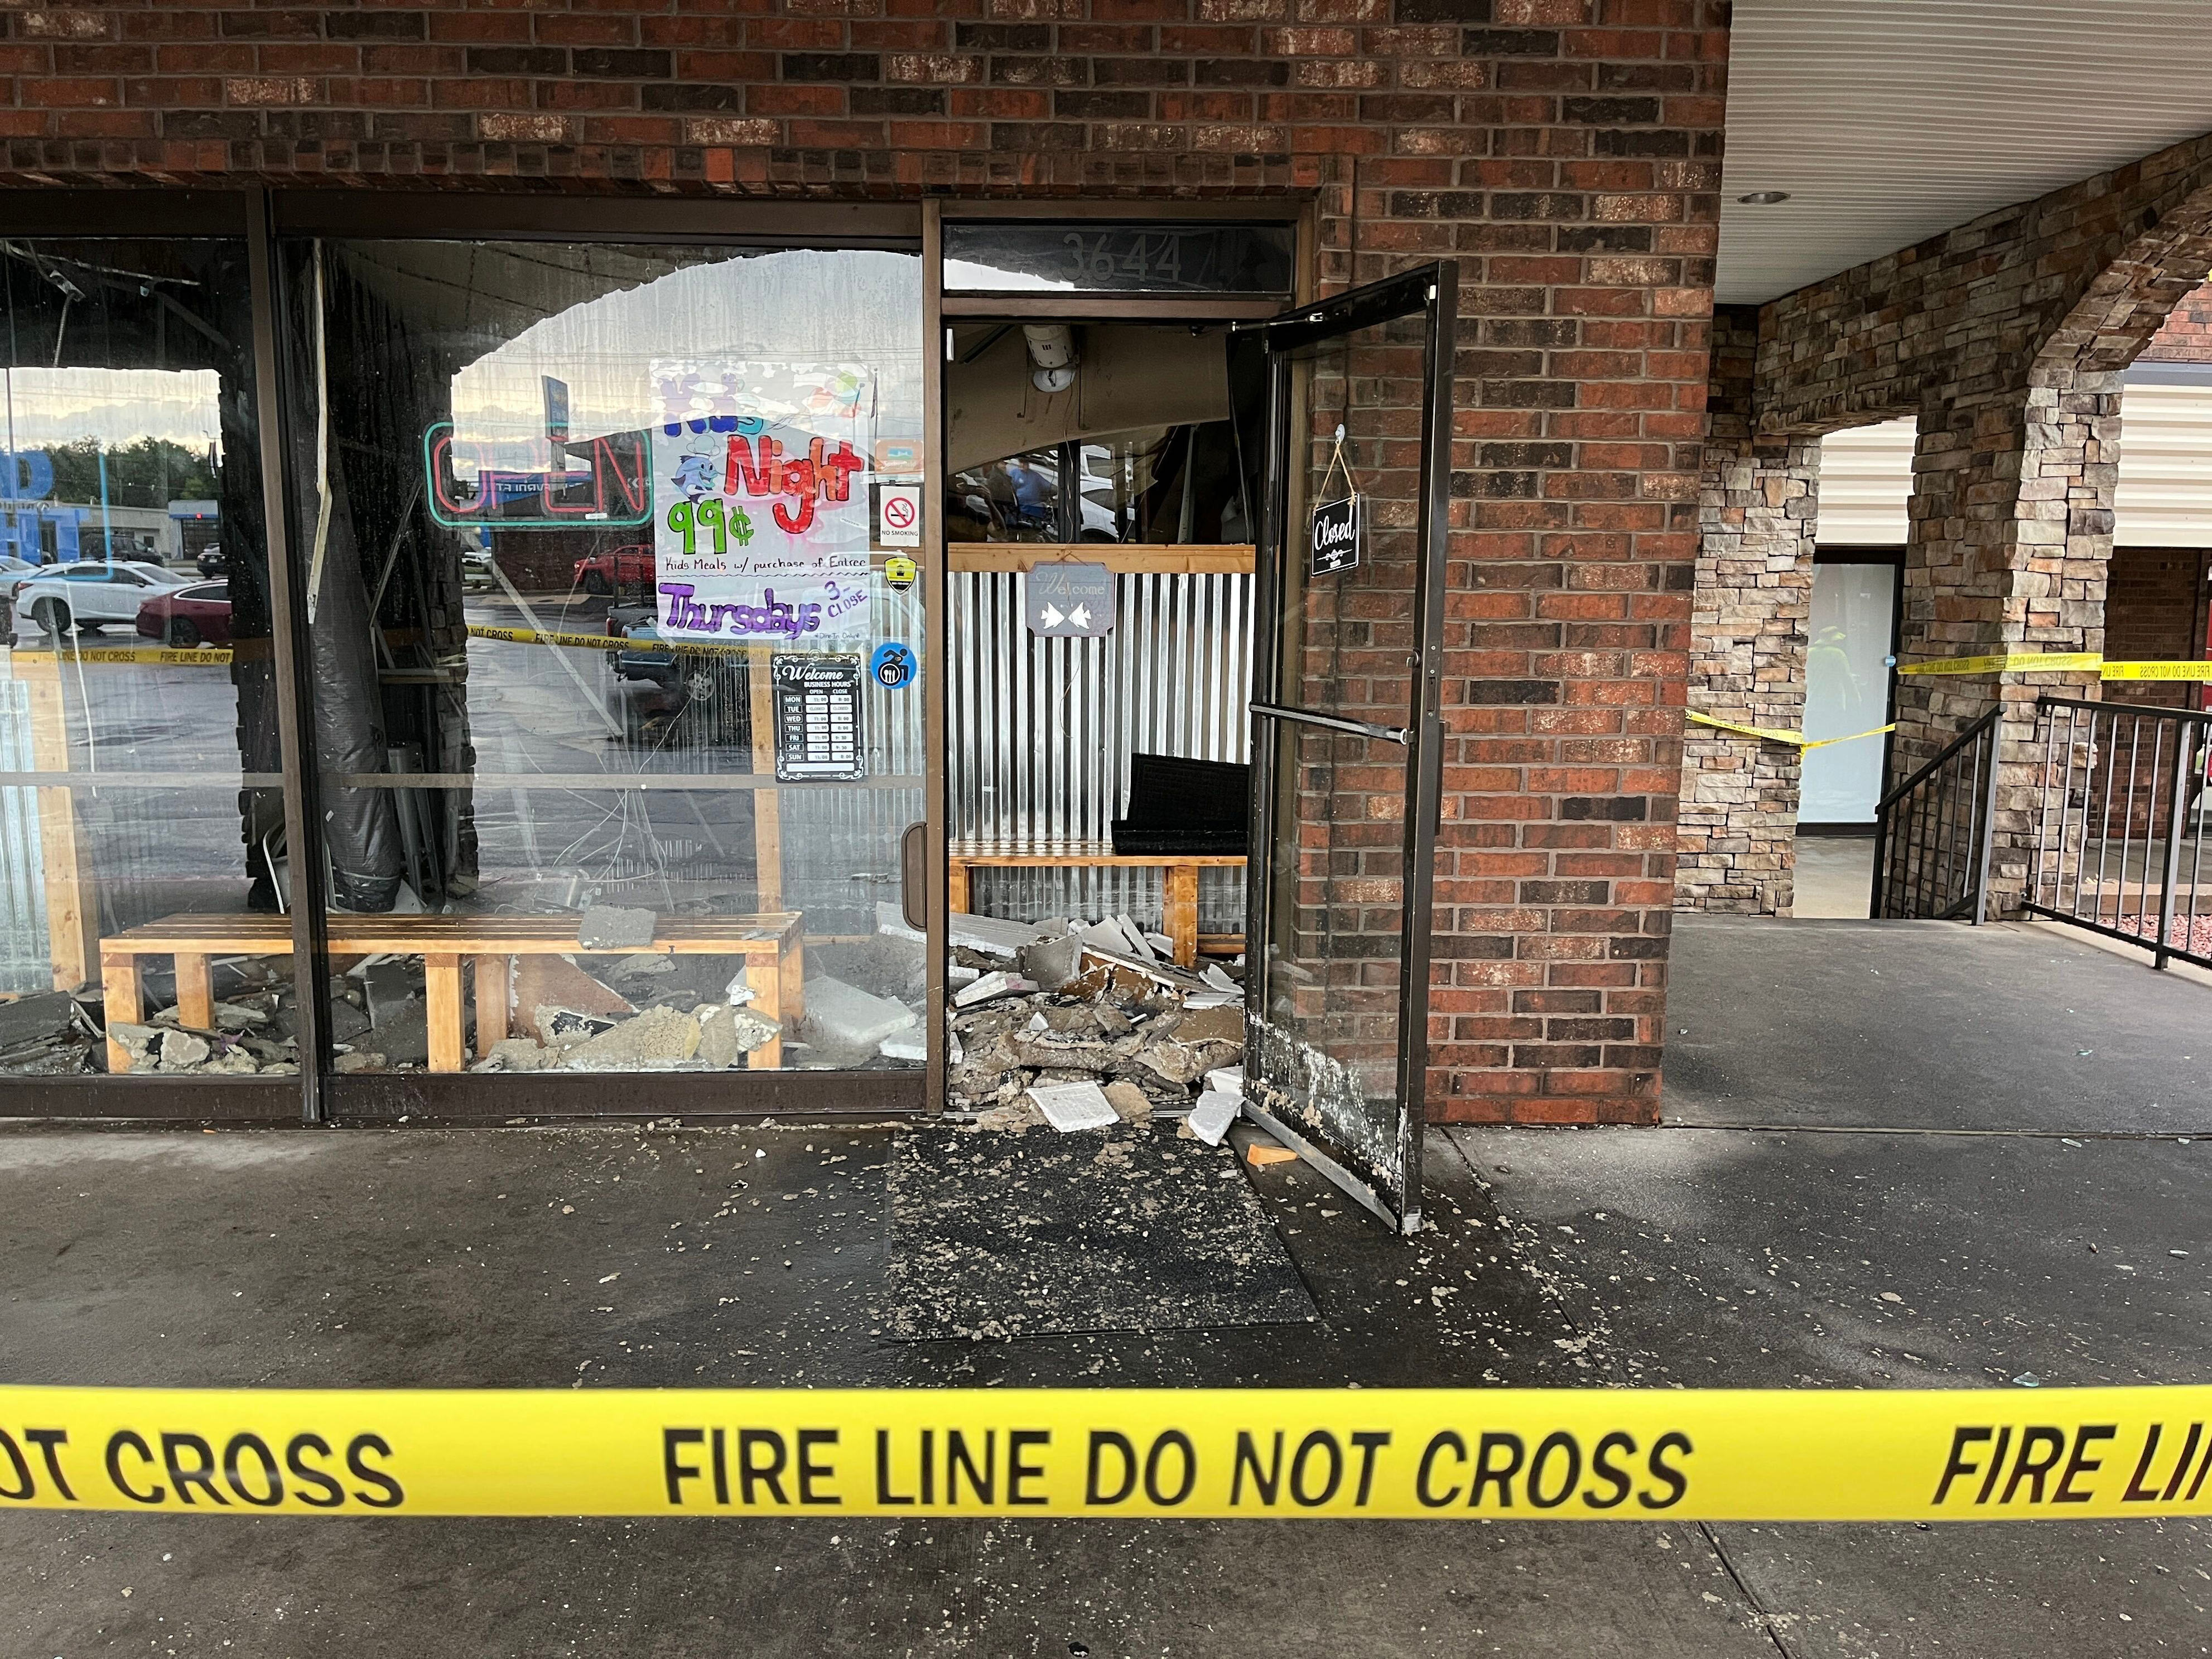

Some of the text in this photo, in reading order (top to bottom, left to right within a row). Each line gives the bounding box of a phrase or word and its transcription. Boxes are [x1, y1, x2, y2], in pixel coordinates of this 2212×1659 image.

[1062, 232, 1182, 282] 3644
[724, 435, 865, 534] Night
[667, 498, 754, 555] 99¢
[1314, 505, 1356, 551] Closed
[666, 556, 866, 573] Kids Meals w/ purchase of Entree
[1035, 571, 1105, 595] Welcome
[658, 582, 822, 640] Thursdays
[827, 589, 868, 618] CLOSE
[486, 629, 513, 642] CROSS
[575, 637, 585, 646] DO
[587, 638, 601, 648] NOT
[652, 644, 669, 652] FIRE
[90, 651, 107, 662] NOT
[108, 650, 136, 662] CROSS
[160, 651, 230, 663] FIRE LINE DO NOT
[782, 663, 844, 681] Welcome
[105, 1430, 404, 1508] CROSS
[663, 1428, 1694, 1510] FIRE LINE DO NOT CROSS
[1930, 1425, 2117, 1505] FIRE
